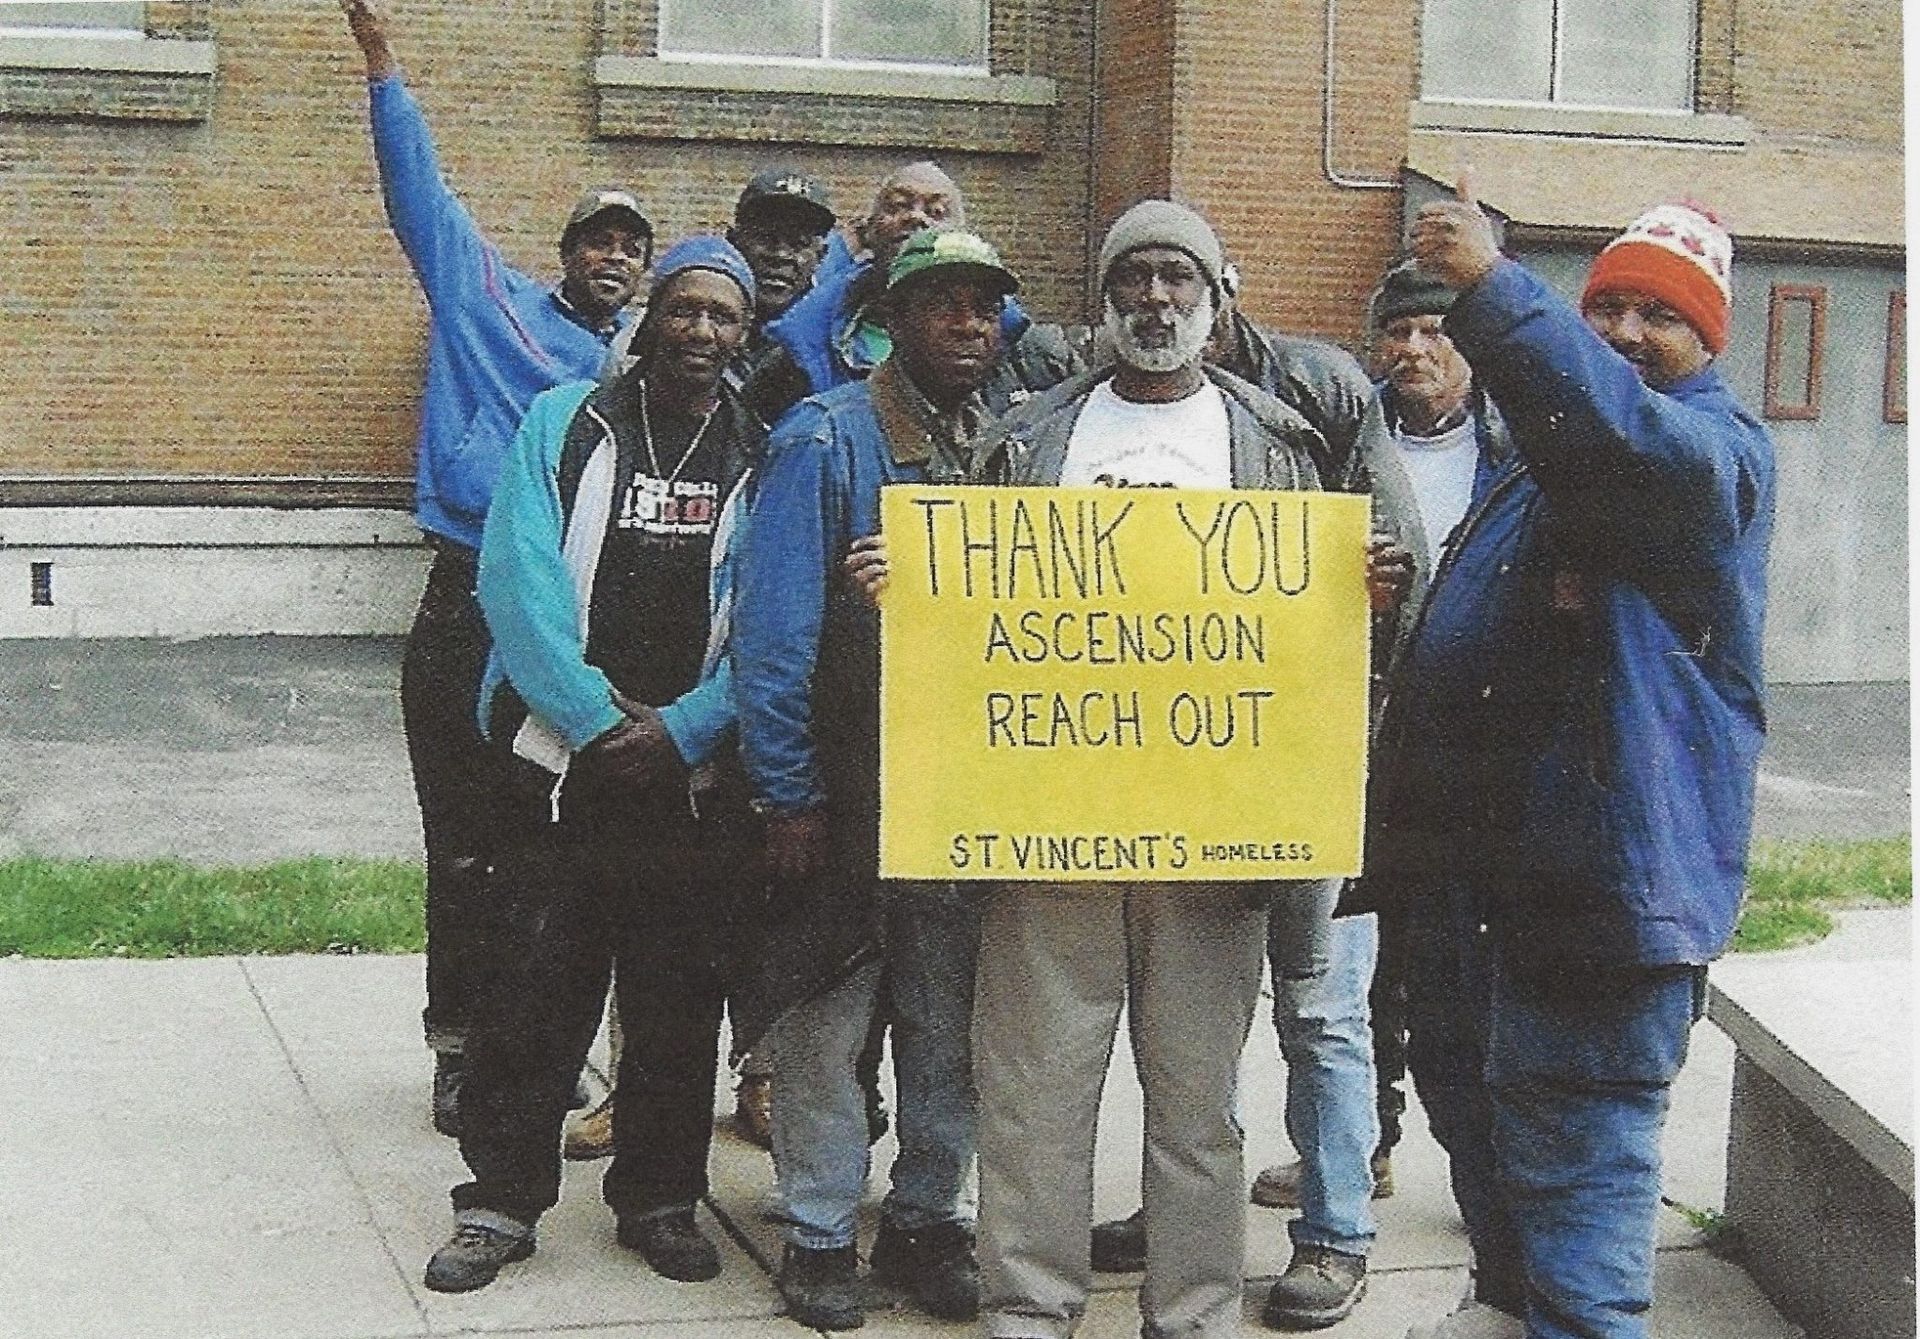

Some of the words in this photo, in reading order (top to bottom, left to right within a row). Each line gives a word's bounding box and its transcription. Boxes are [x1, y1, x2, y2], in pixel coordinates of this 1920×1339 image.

[911, 500, 1133, 599] THANK
[1177, 501, 1309, 596] YOU
[985, 611, 1264, 664] ASCENSION
[987, 692, 1141, 747] REACH
[1171, 692, 1274, 747] OUT
[1012, 834, 1187, 871] VINCENT'S
[1202, 844, 1312, 861] HOMELESS
